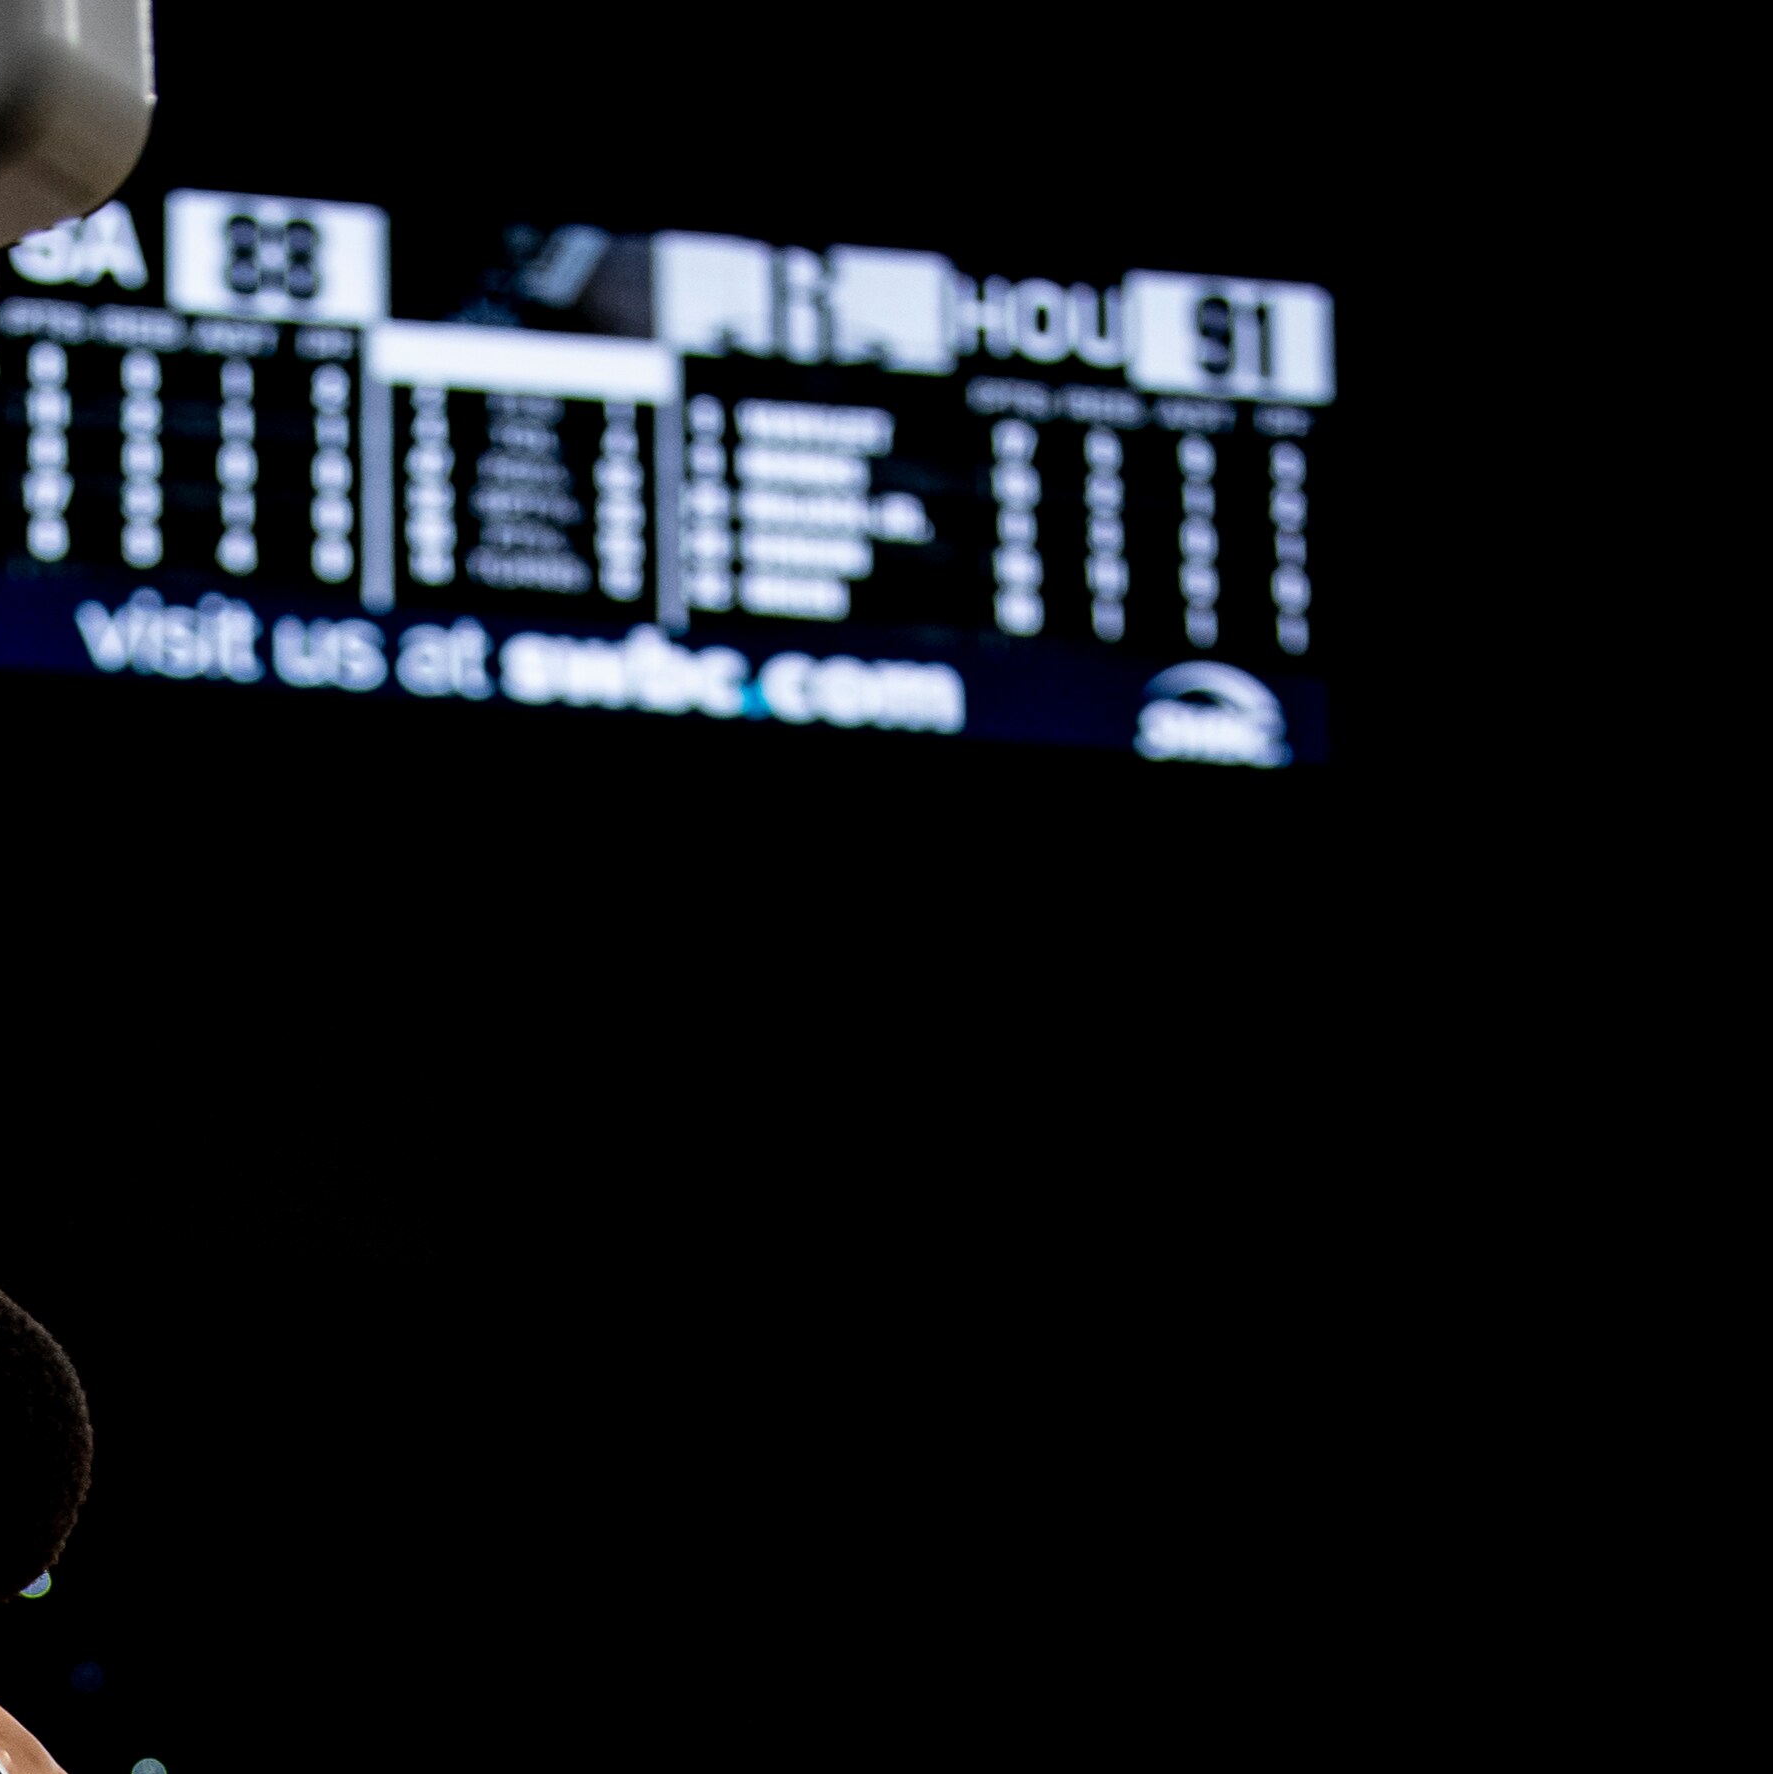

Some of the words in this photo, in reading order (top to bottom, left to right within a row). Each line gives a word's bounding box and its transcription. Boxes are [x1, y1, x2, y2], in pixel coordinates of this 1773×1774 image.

[953, 276, 1125, 367] HOU
[76, 587, 264, 682] visit
[273, 616, 388, 691] us
[397, 616, 493, 699] at
